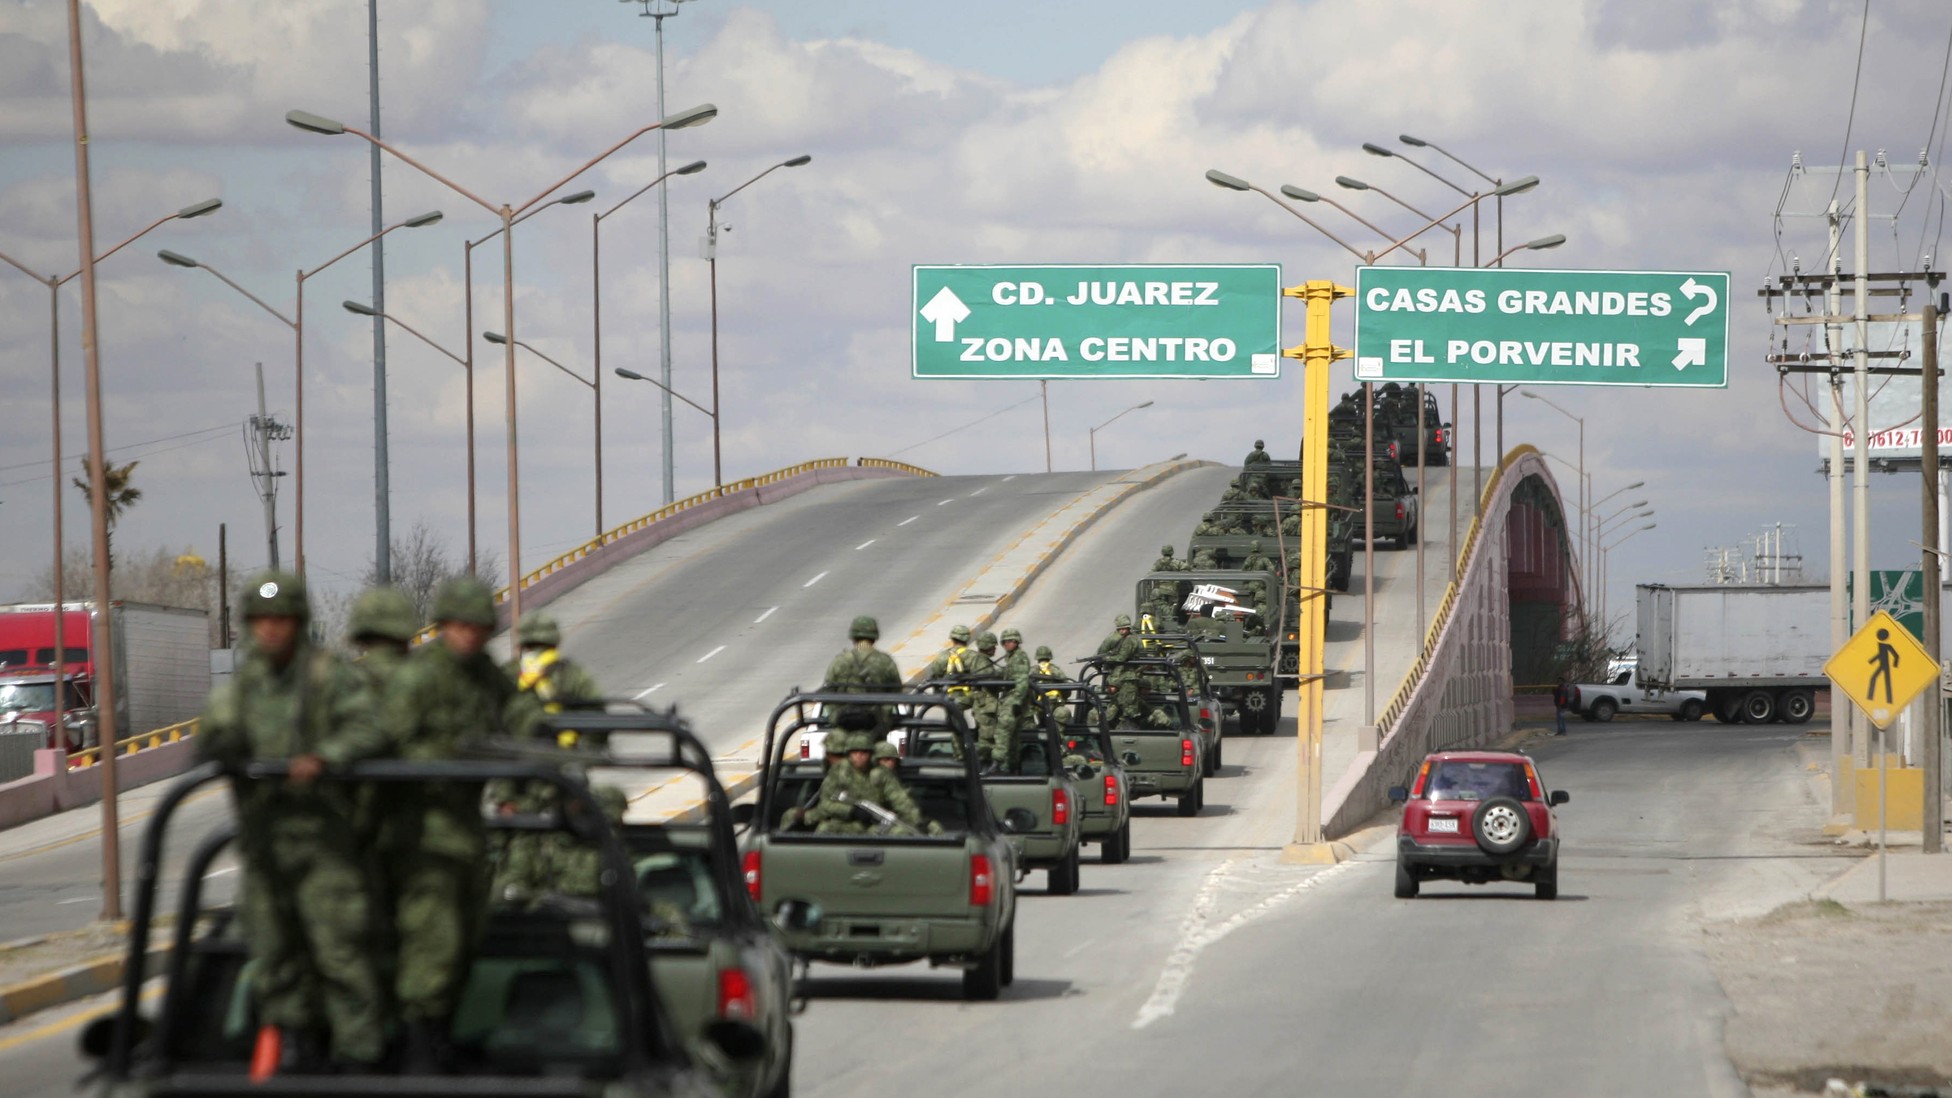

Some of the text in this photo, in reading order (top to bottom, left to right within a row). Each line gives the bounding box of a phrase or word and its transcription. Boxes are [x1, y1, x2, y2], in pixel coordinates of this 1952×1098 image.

[991, 281, 1219, 306] CD. JUAREZ
[1366, 287, 1672, 317] CASAS GRANDES
[959, 337, 1237, 362] ZONA CENTRO
[1390, 339, 1641, 367] EL PORVENIR
